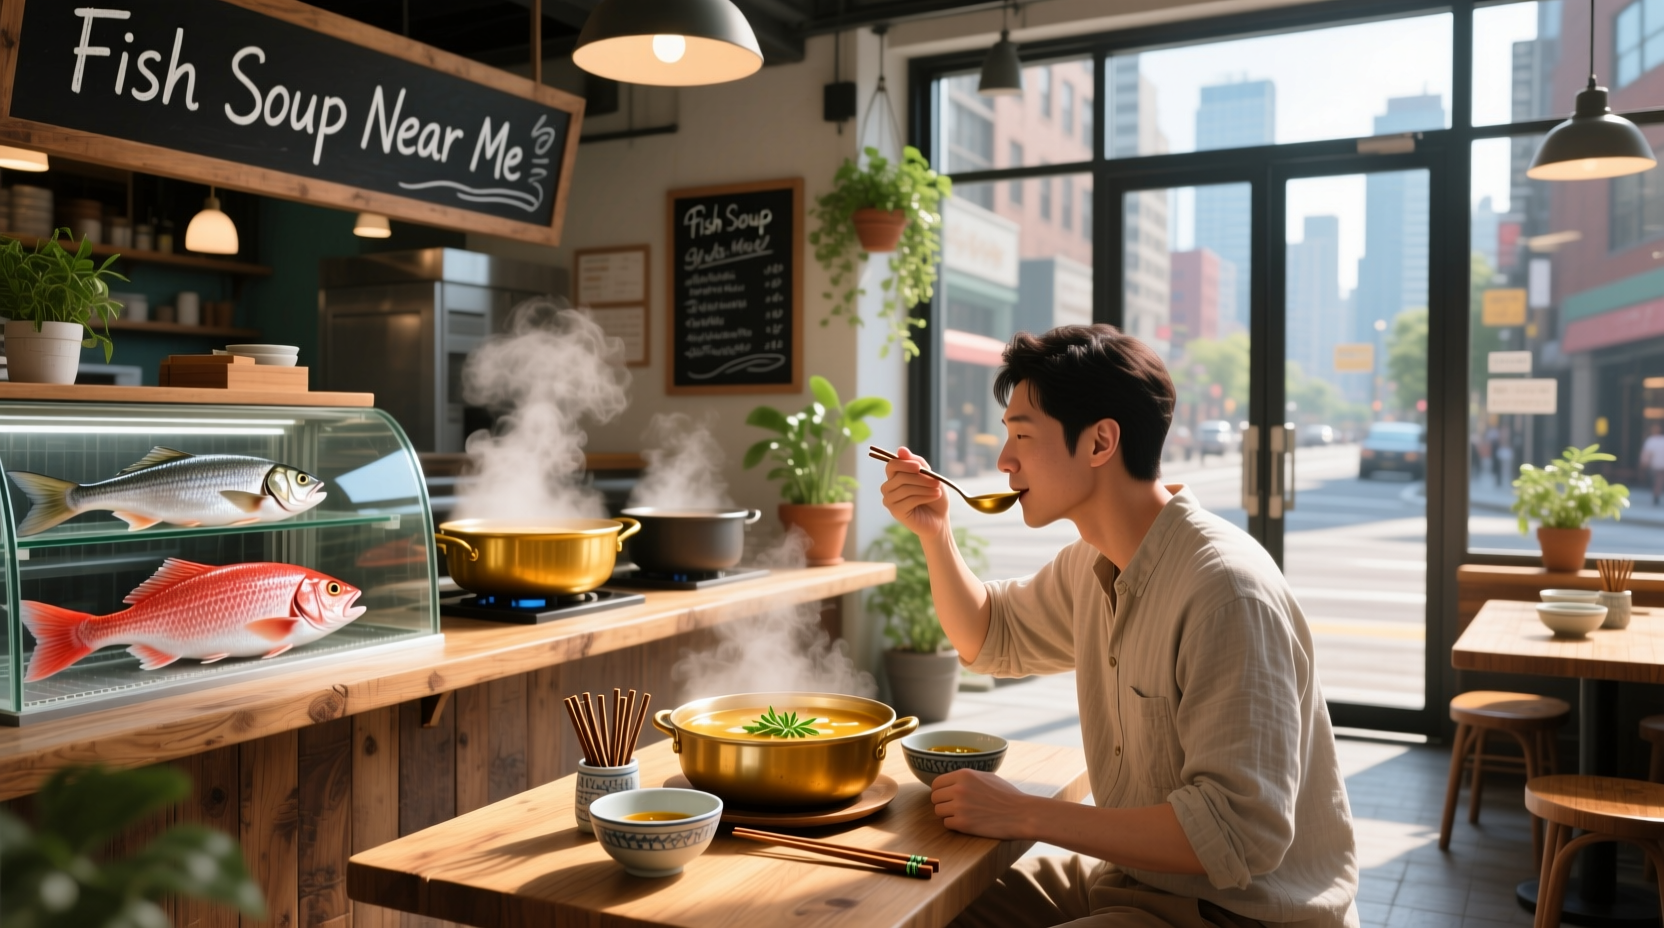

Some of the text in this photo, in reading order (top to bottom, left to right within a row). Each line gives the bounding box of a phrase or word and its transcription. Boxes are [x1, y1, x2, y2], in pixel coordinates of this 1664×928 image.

[71, 7, 199, 111] Fish
[225, 46, 347, 165] Soup
[361, 85, 464, 163] Near
[470, 116, 523, 181] Me
[683, 203, 773, 238] Fish Soup
